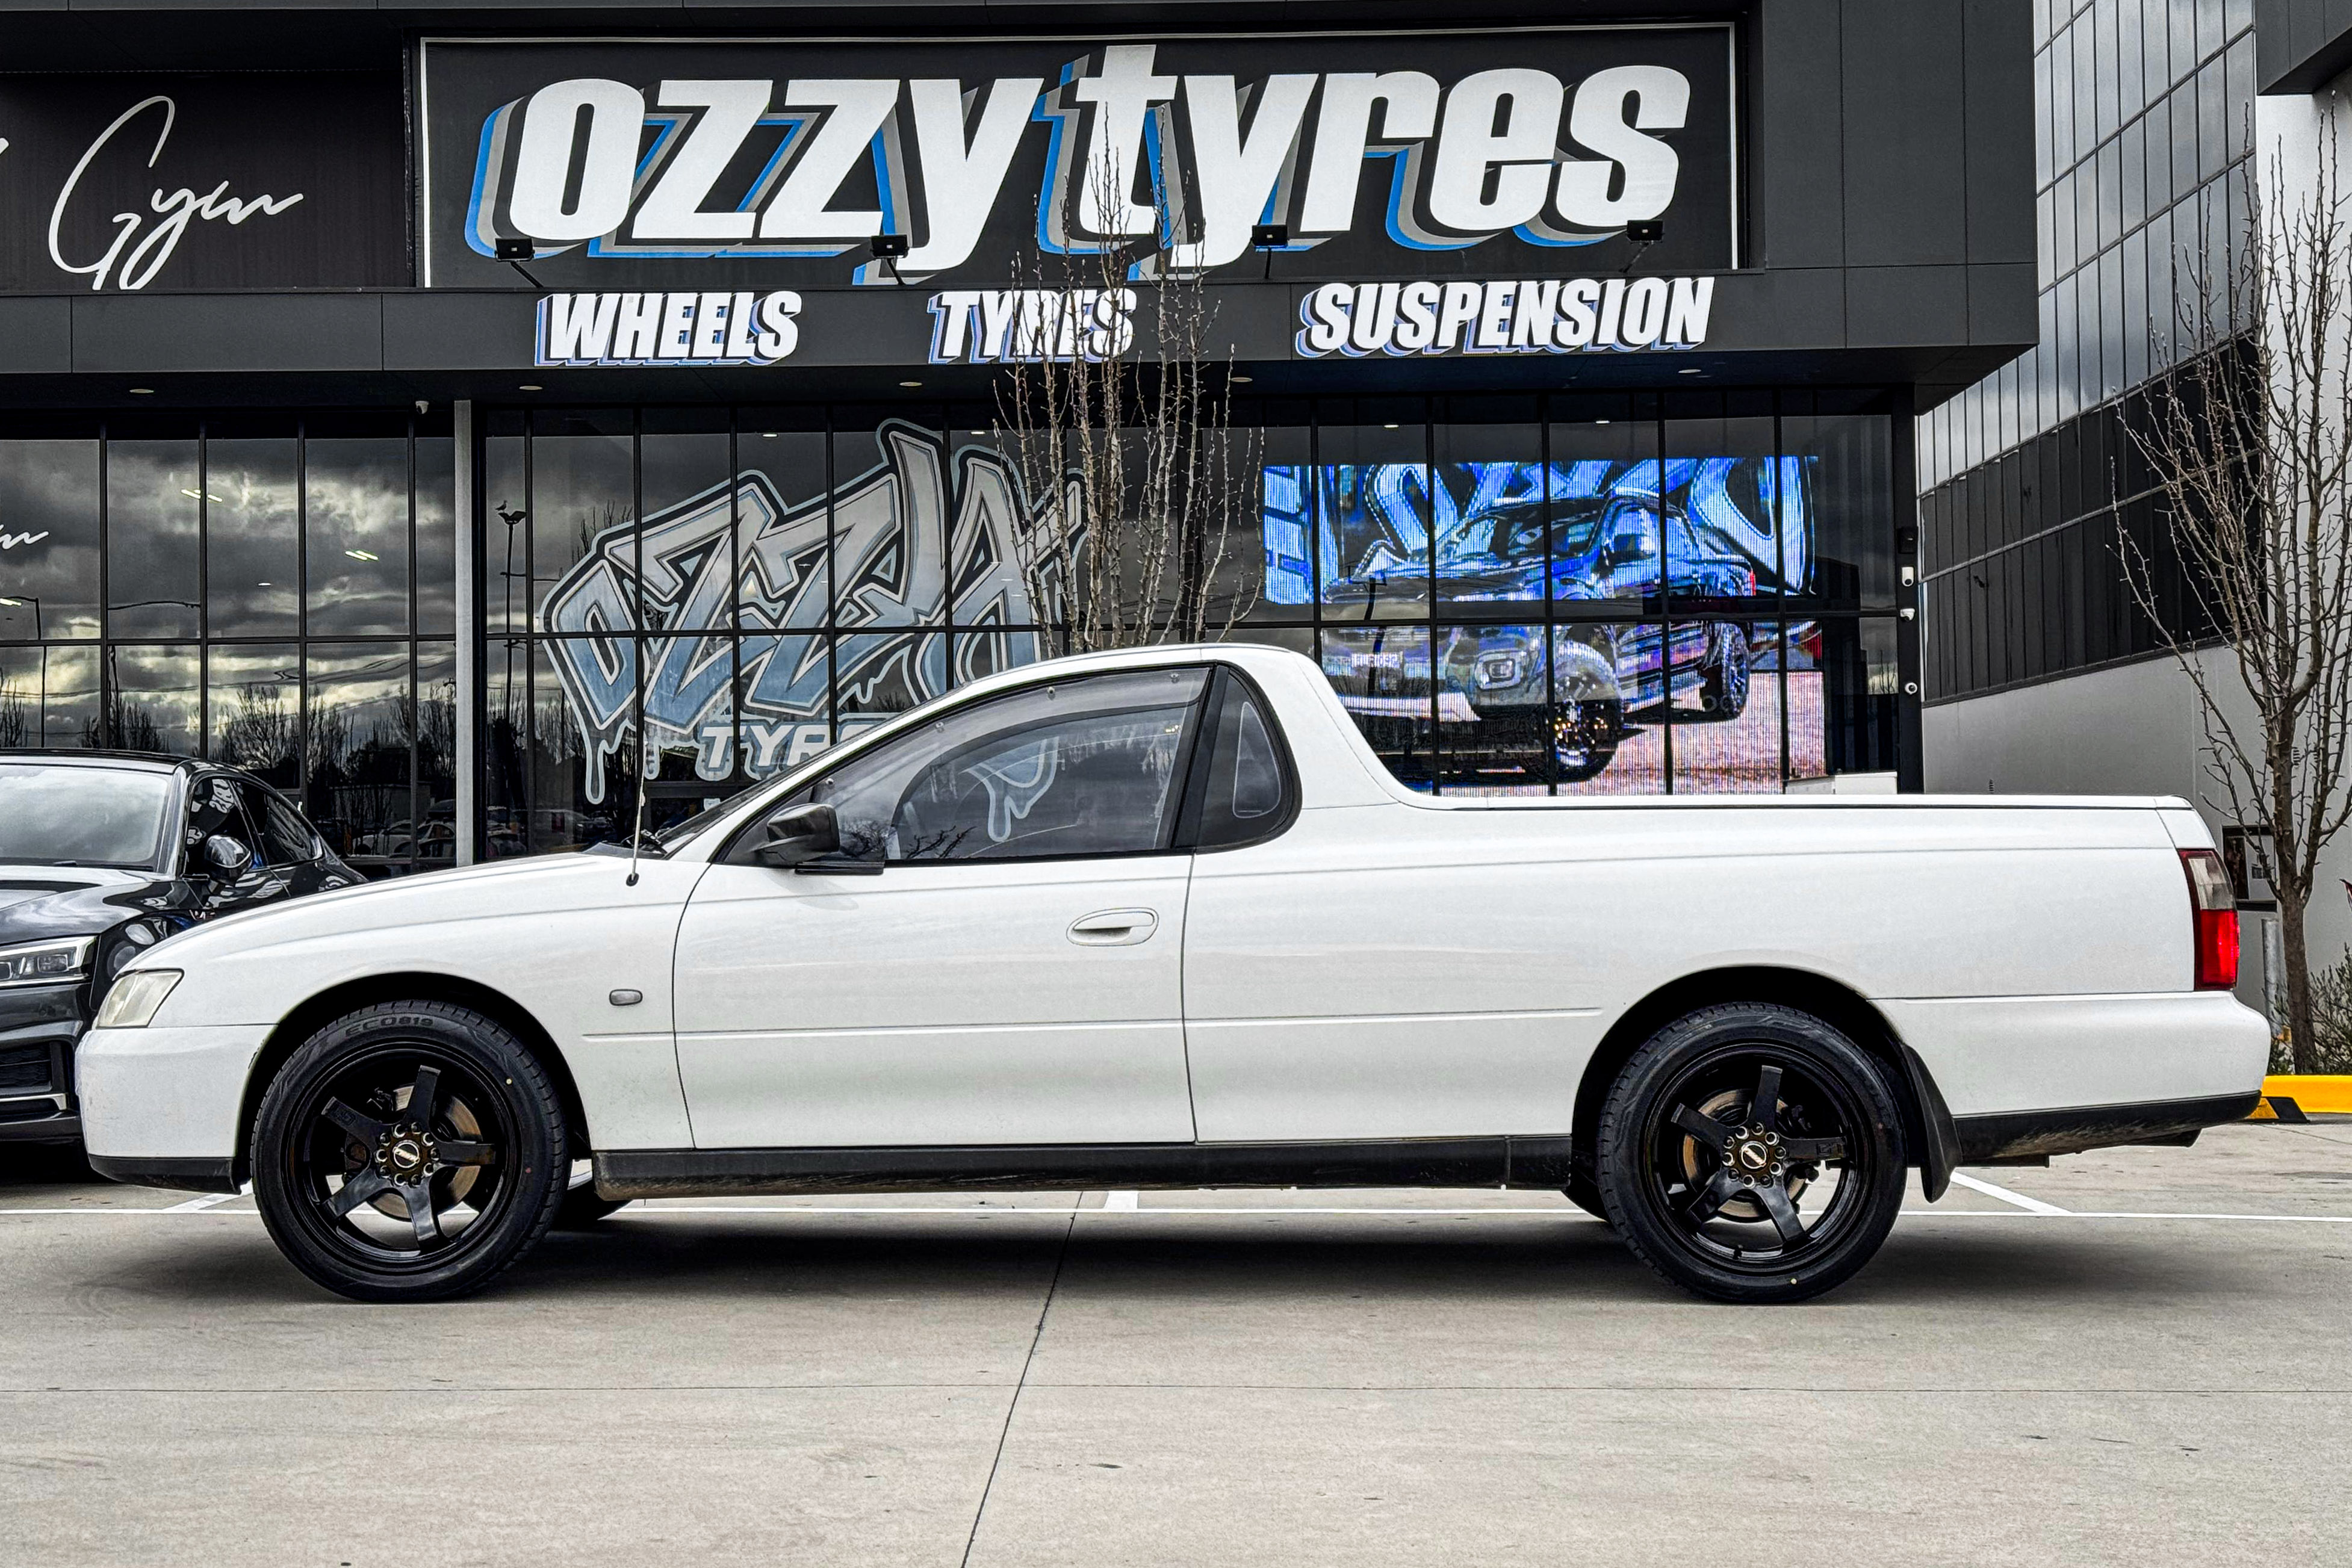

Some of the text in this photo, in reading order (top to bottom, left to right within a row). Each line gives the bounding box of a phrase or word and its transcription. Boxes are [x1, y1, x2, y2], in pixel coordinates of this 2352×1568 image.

[49, 96, 304, 290] Gym
[536, 291, 802, 367] WHEELS
[928, 288, 1138, 365] TYRES
[1297, 277, 1714, 358] SUSPENSION
